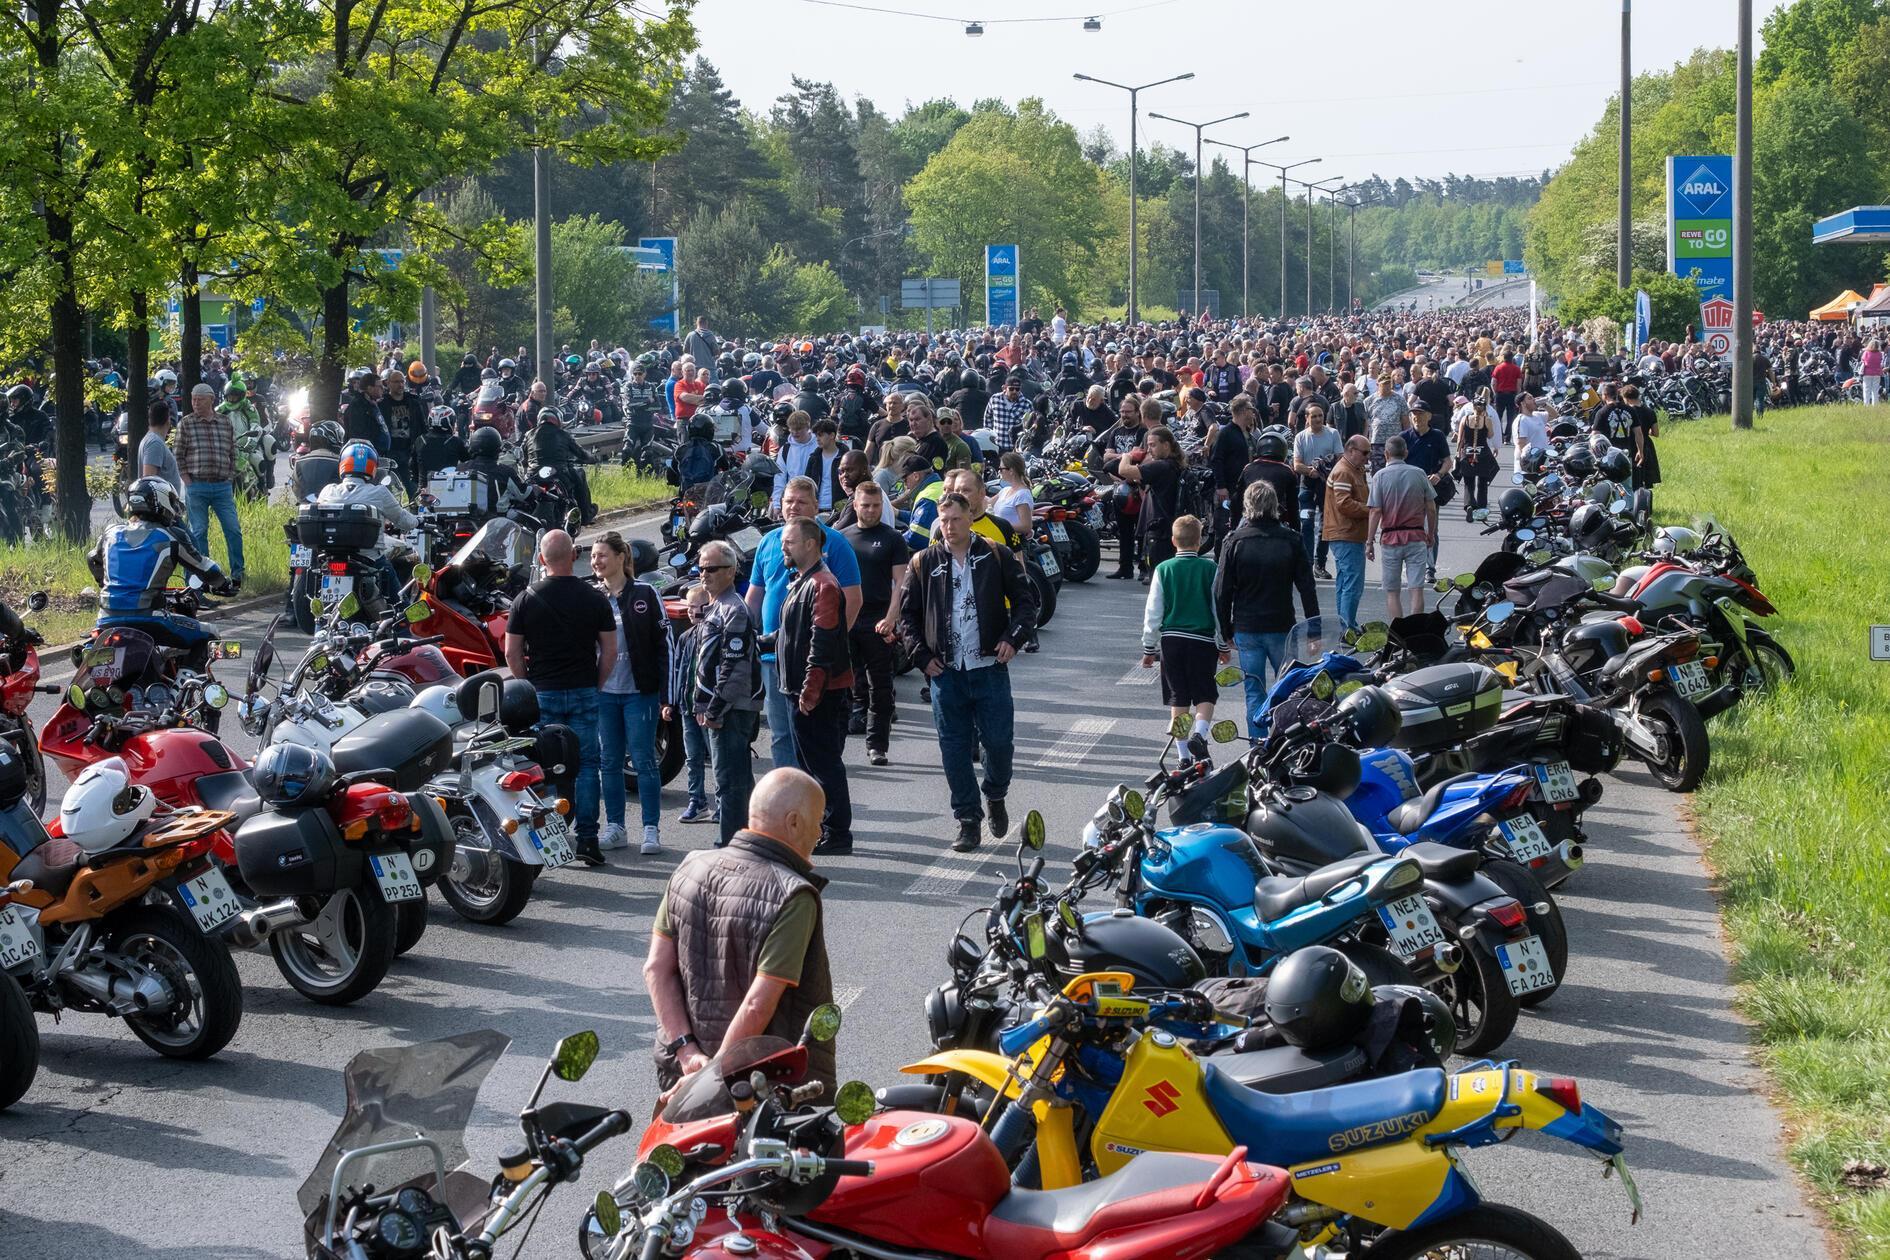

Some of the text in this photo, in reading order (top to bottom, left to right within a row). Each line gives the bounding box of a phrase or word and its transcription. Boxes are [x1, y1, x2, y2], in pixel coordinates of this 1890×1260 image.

[1684, 182, 1721, 195] ARAL
[1705, 229, 1727, 242] GO
[1689, 240, 1704, 248] TO
[255, 299, 261, 308] P
[1703, 301, 1733, 328] UTA
[1714, 340, 1724, 349] 10
[334, 577, 341, 585] N
[1678, 665, 1689, 679] N
[1688, 675, 1710, 692] 642
[1546, 762, 1570, 777] ERH
[1550, 787, 1575, 801] CN 6
[1508, 815, 1534, 832] NEA
[537, 823, 560, 841] LAU
[544, 848, 573, 868] LT 66
[1515, 841, 1549, 861] FF 94
[386, 855, 397, 869] N
[419, 853, 428, 868] D
[195, 876, 209, 891] N
[384, 883, 421, 900] PP 252
[199, 898, 241, 929] WK 124
[1392, 896, 1421, 917] NEA
[1398, 926, 1443, 954] MN 154
[1, 940, 37, 966] AC 49
[1519, 941, 1530, 956] N
[1510, 970, 1554, 993] FA 226
[1328, 1110, 1429, 1152] SUZUKI
